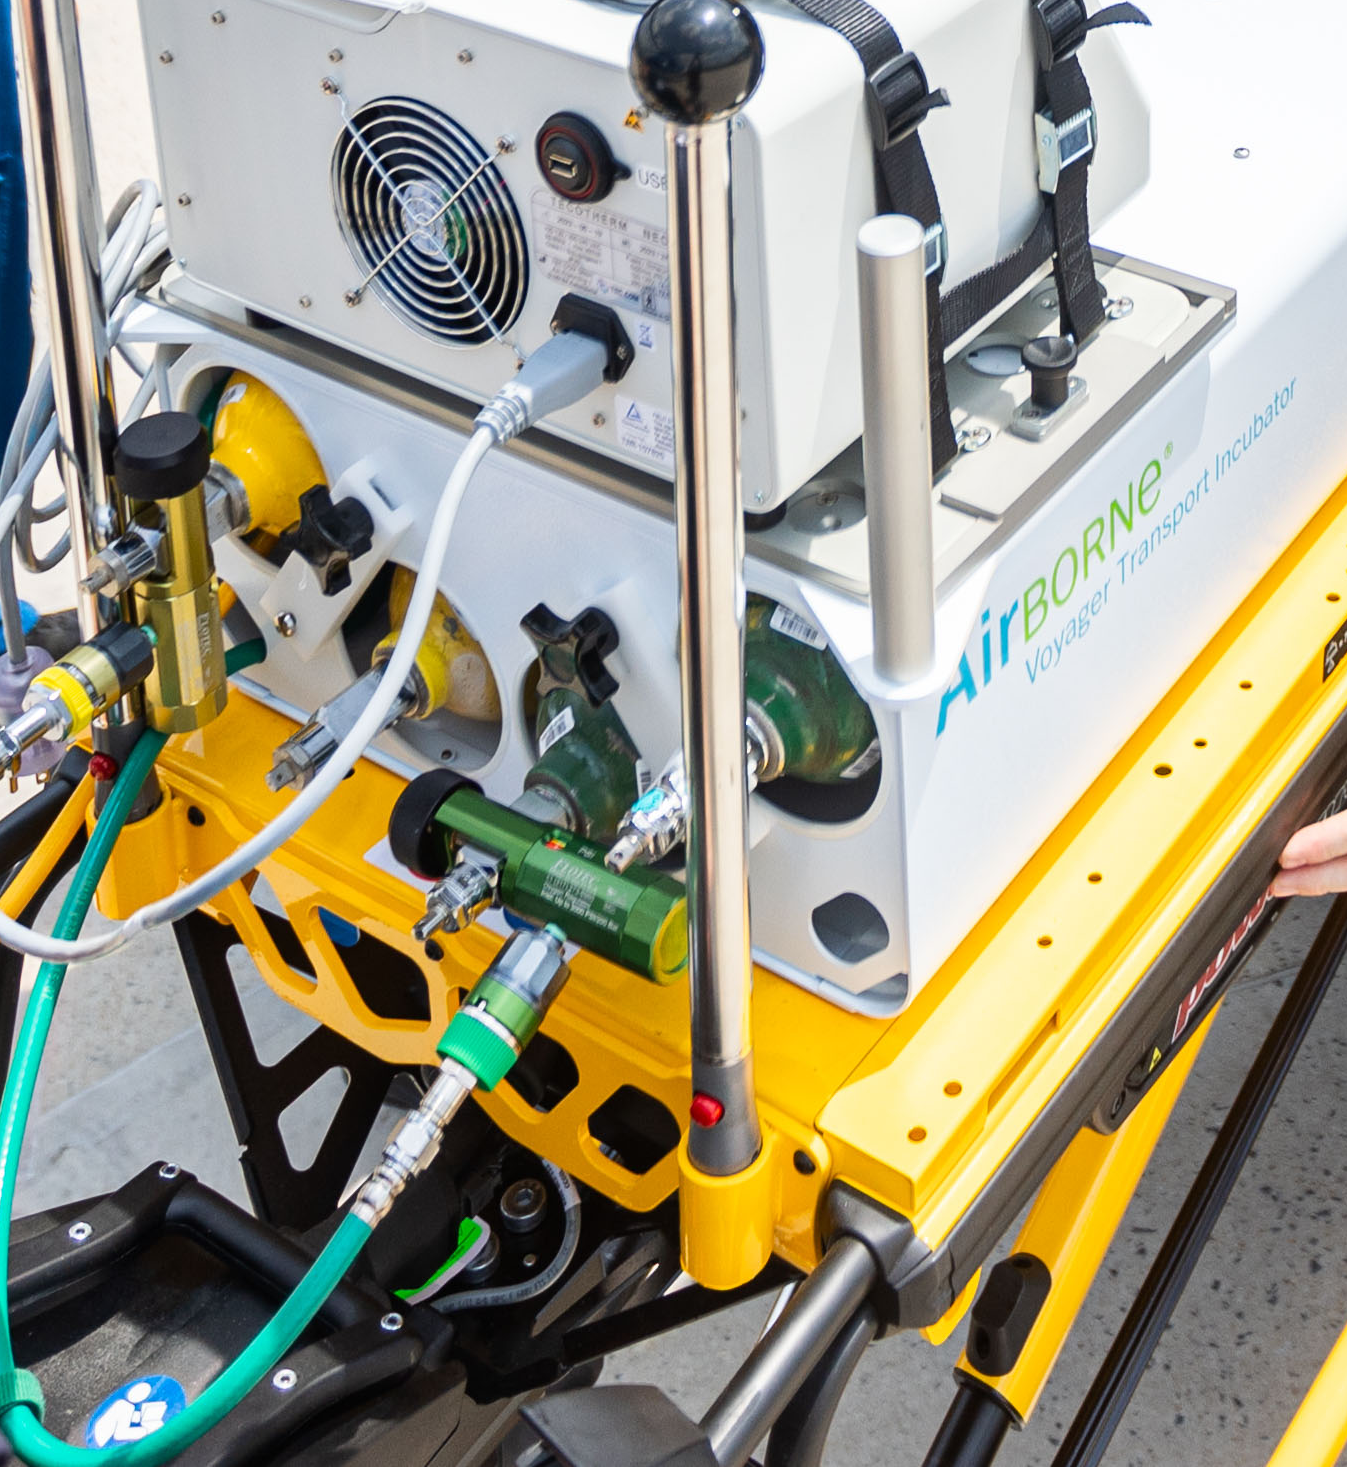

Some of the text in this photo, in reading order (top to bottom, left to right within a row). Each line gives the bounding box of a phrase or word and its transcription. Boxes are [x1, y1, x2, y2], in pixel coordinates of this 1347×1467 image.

[550, 196, 628, 231] TECOTHERM
[1024, 376, 1298, 686] Voyager Transport Incubator
